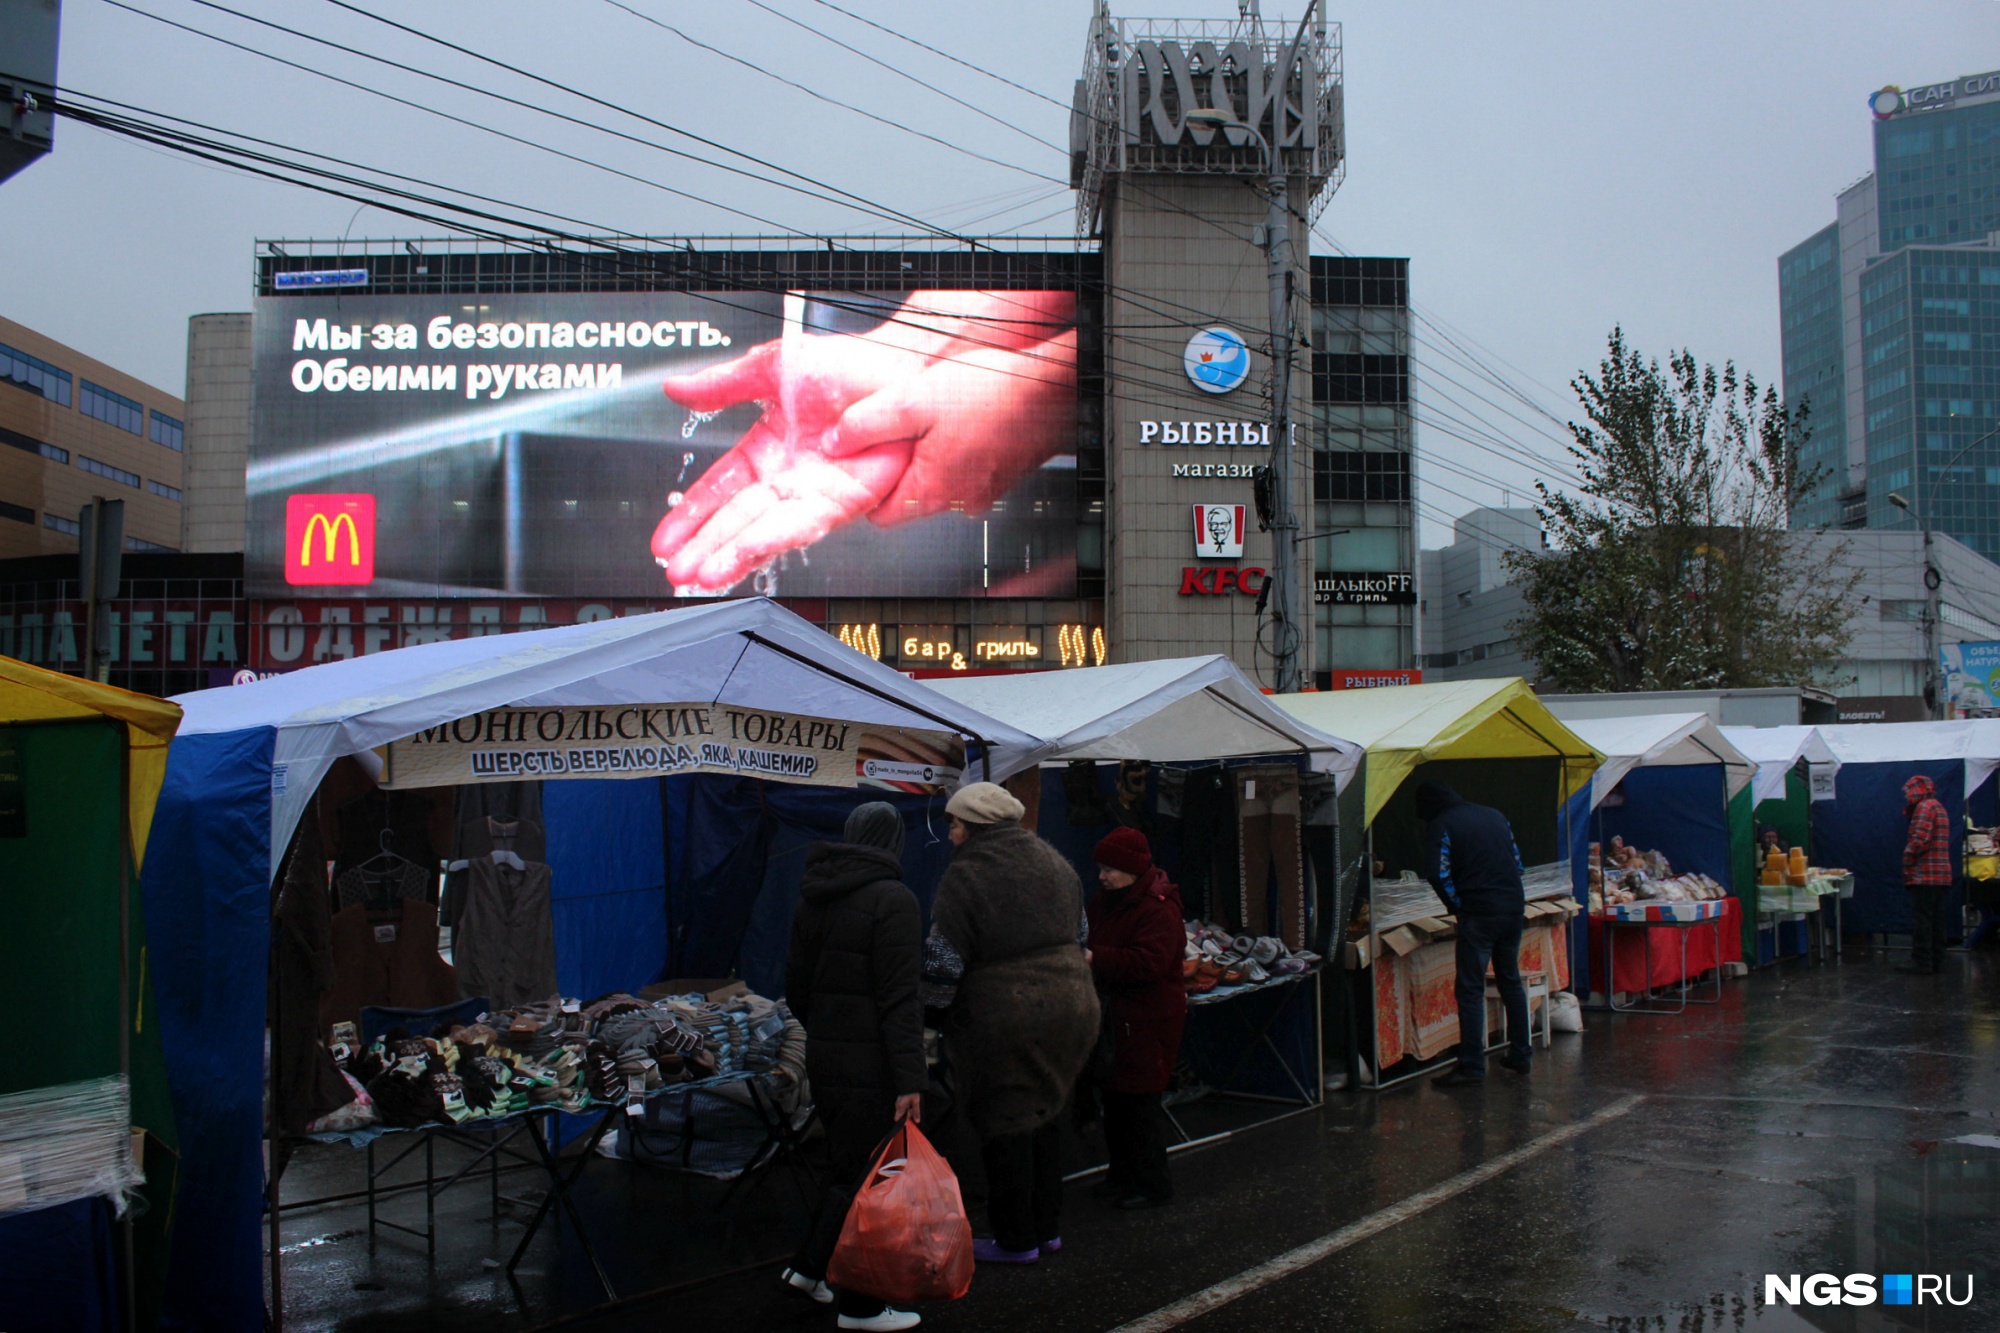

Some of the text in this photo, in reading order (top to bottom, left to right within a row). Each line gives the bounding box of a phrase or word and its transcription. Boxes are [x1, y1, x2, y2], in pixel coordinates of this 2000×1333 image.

[1911, 83, 1955, 104] САН
[292, 316, 732, 351] Мы за безопасность.
[290, 357, 624, 399] Обеими руками
[1139, 420, 1297, 446] РЫБНЫ
[1172, 463, 1269, 478] магази
[1178, 566, 1266, 596] KFC
[1336, 592, 1345, 602] &
[1350, 593, 1388, 603] гриль
[904, 637, 1039, 671] бар & гриль
[1966, 657, 2000, 667] НАТУР
[1970, 646, 2000, 656] ОБЪЕ
[1345, 674, 1410, 688] РЫБНЫЙ
[726, 710, 850, 752] ТОВАРЫ
[472, 744, 817, 775] ШЕРСТЬ ВЕРБЛЮДА, ЯКА, КАШЕМИР
